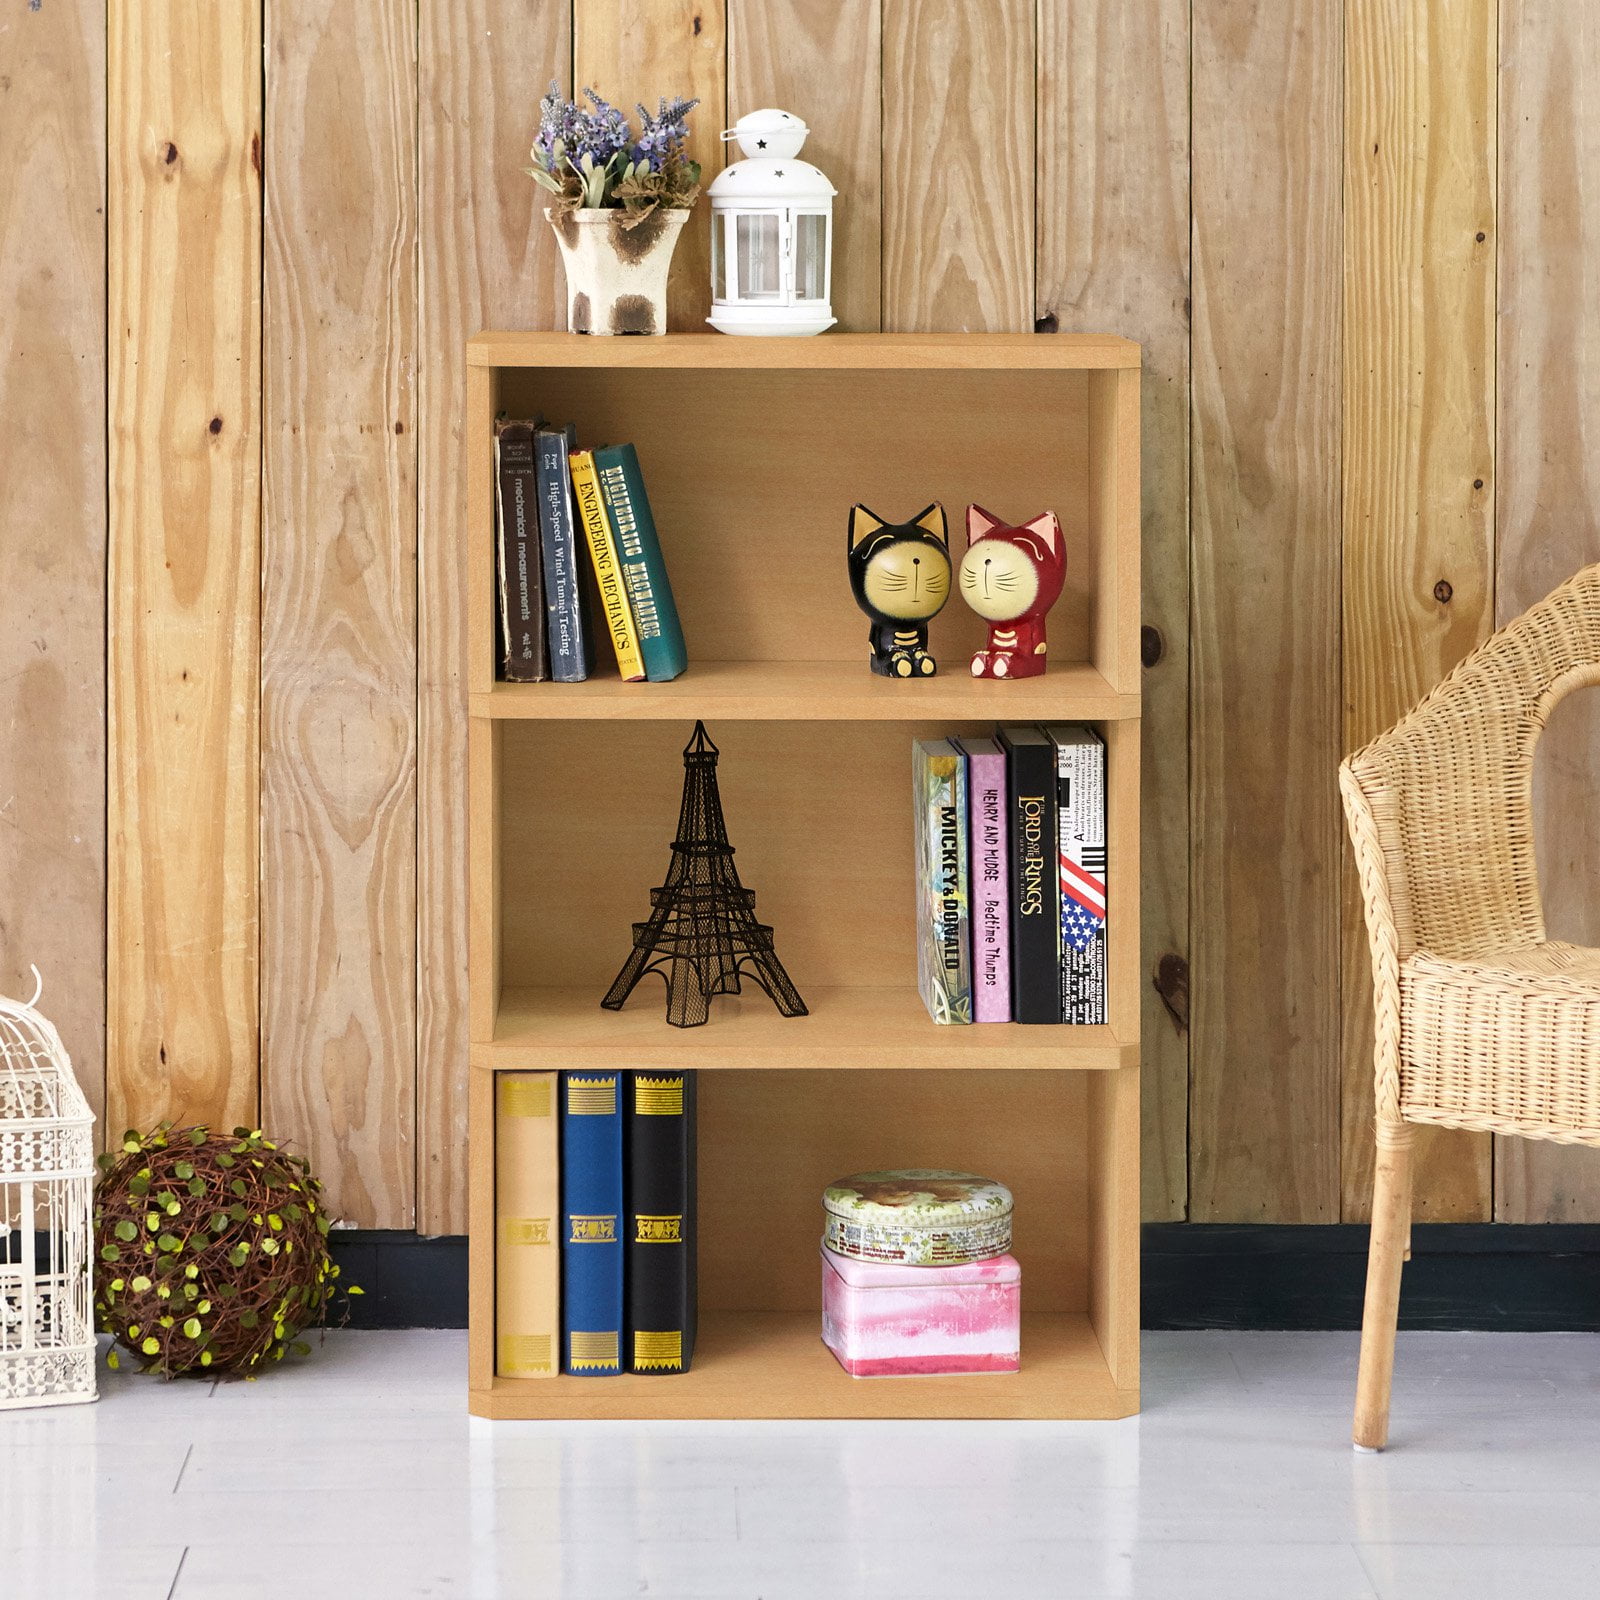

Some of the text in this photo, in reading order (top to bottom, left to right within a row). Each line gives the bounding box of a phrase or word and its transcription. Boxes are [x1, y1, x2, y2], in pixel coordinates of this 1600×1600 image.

[551, 453, 559, 471] Pope
[515, 478, 528, 538] mechanical
[605, 465, 643, 557] ENGINEERING
[518, 542, 531, 621] measurements
[547, 481, 571, 656] High-Speed Wind Tunnel Testing
[580, 482, 612, 570] ENGINEERING
[601, 573, 631, 650] MECHANICS
[941, 806, 959, 887] MICKEY
[1019, 796, 1045, 842] LORD
[1033, 843, 1041, 855] OF
[983, 789, 1001, 986] HENRY AND MUDGE Bedtime Thumps
[1020, 856, 1044, 916] RINGS
[943, 899, 961, 970] DONALD
